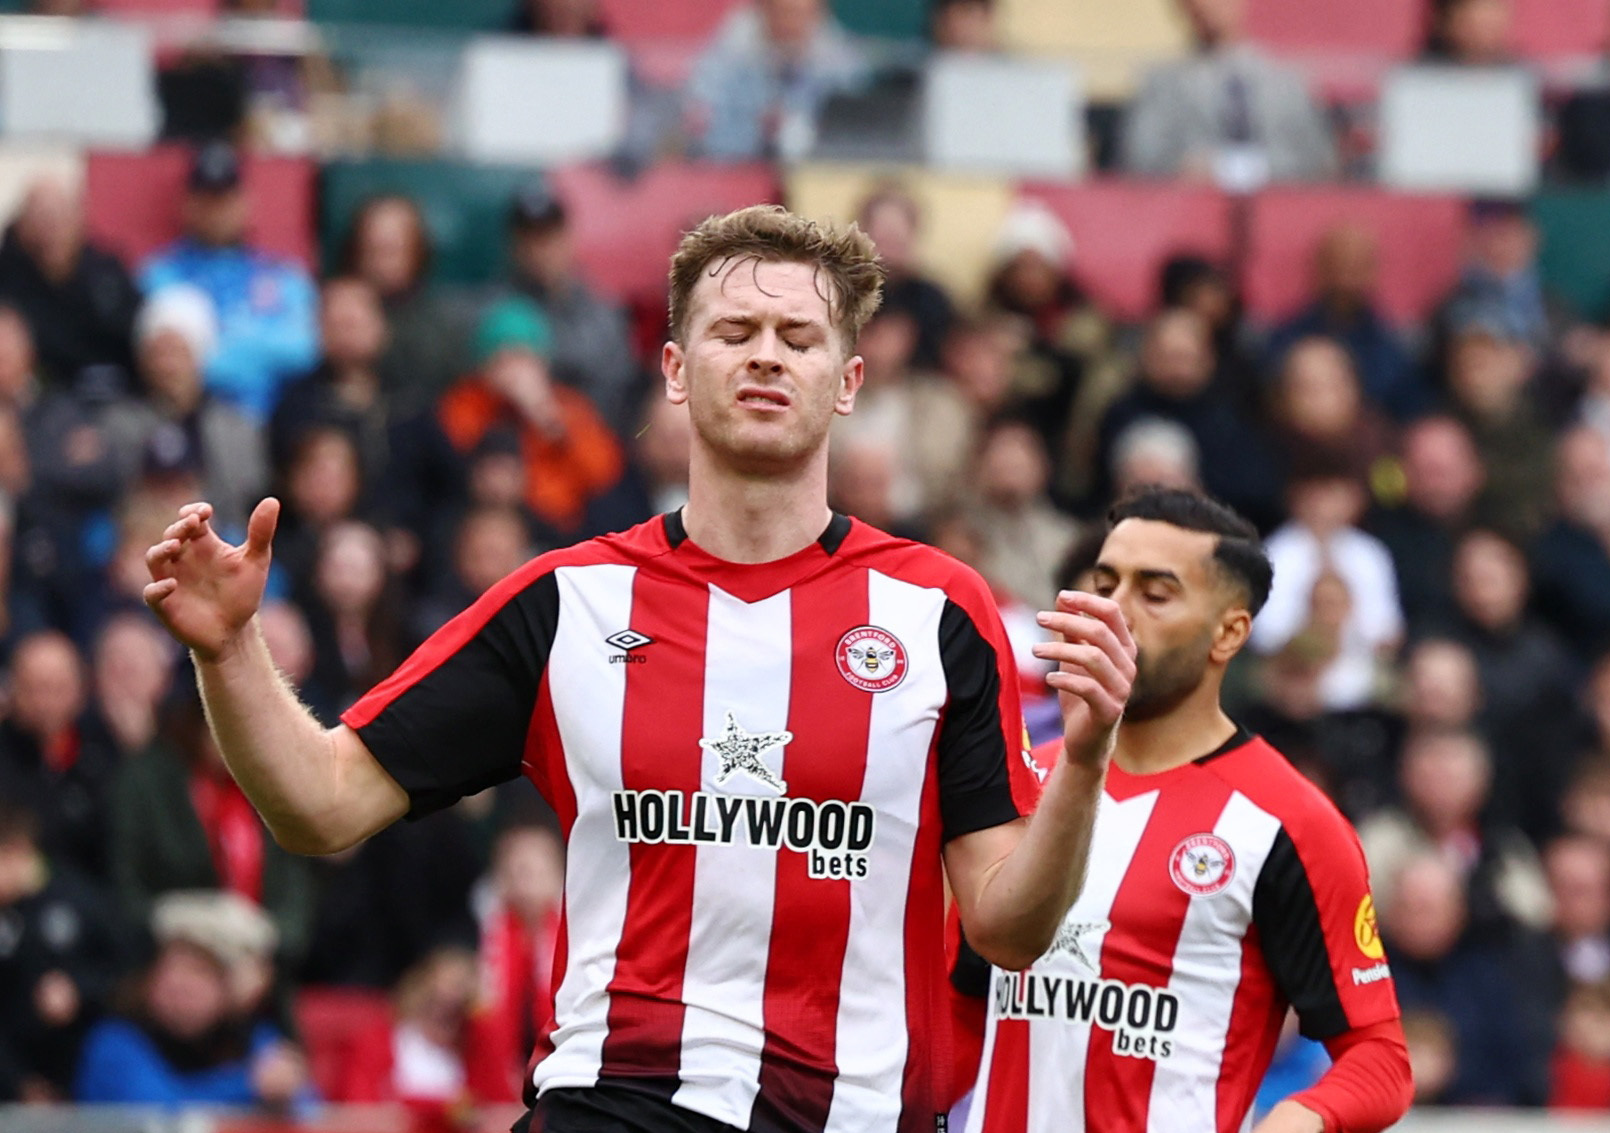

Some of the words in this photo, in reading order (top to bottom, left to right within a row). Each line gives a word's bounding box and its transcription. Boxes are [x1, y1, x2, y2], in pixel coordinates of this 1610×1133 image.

[844, 631, 897, 649] BRENTFORD
[608, 654, 647, 664] umbro
[613, 792, 874, 851] HOLLYWOOD
[812, 849, 868, 878] bets
[1118, 1028, 1172, 1058] bets
